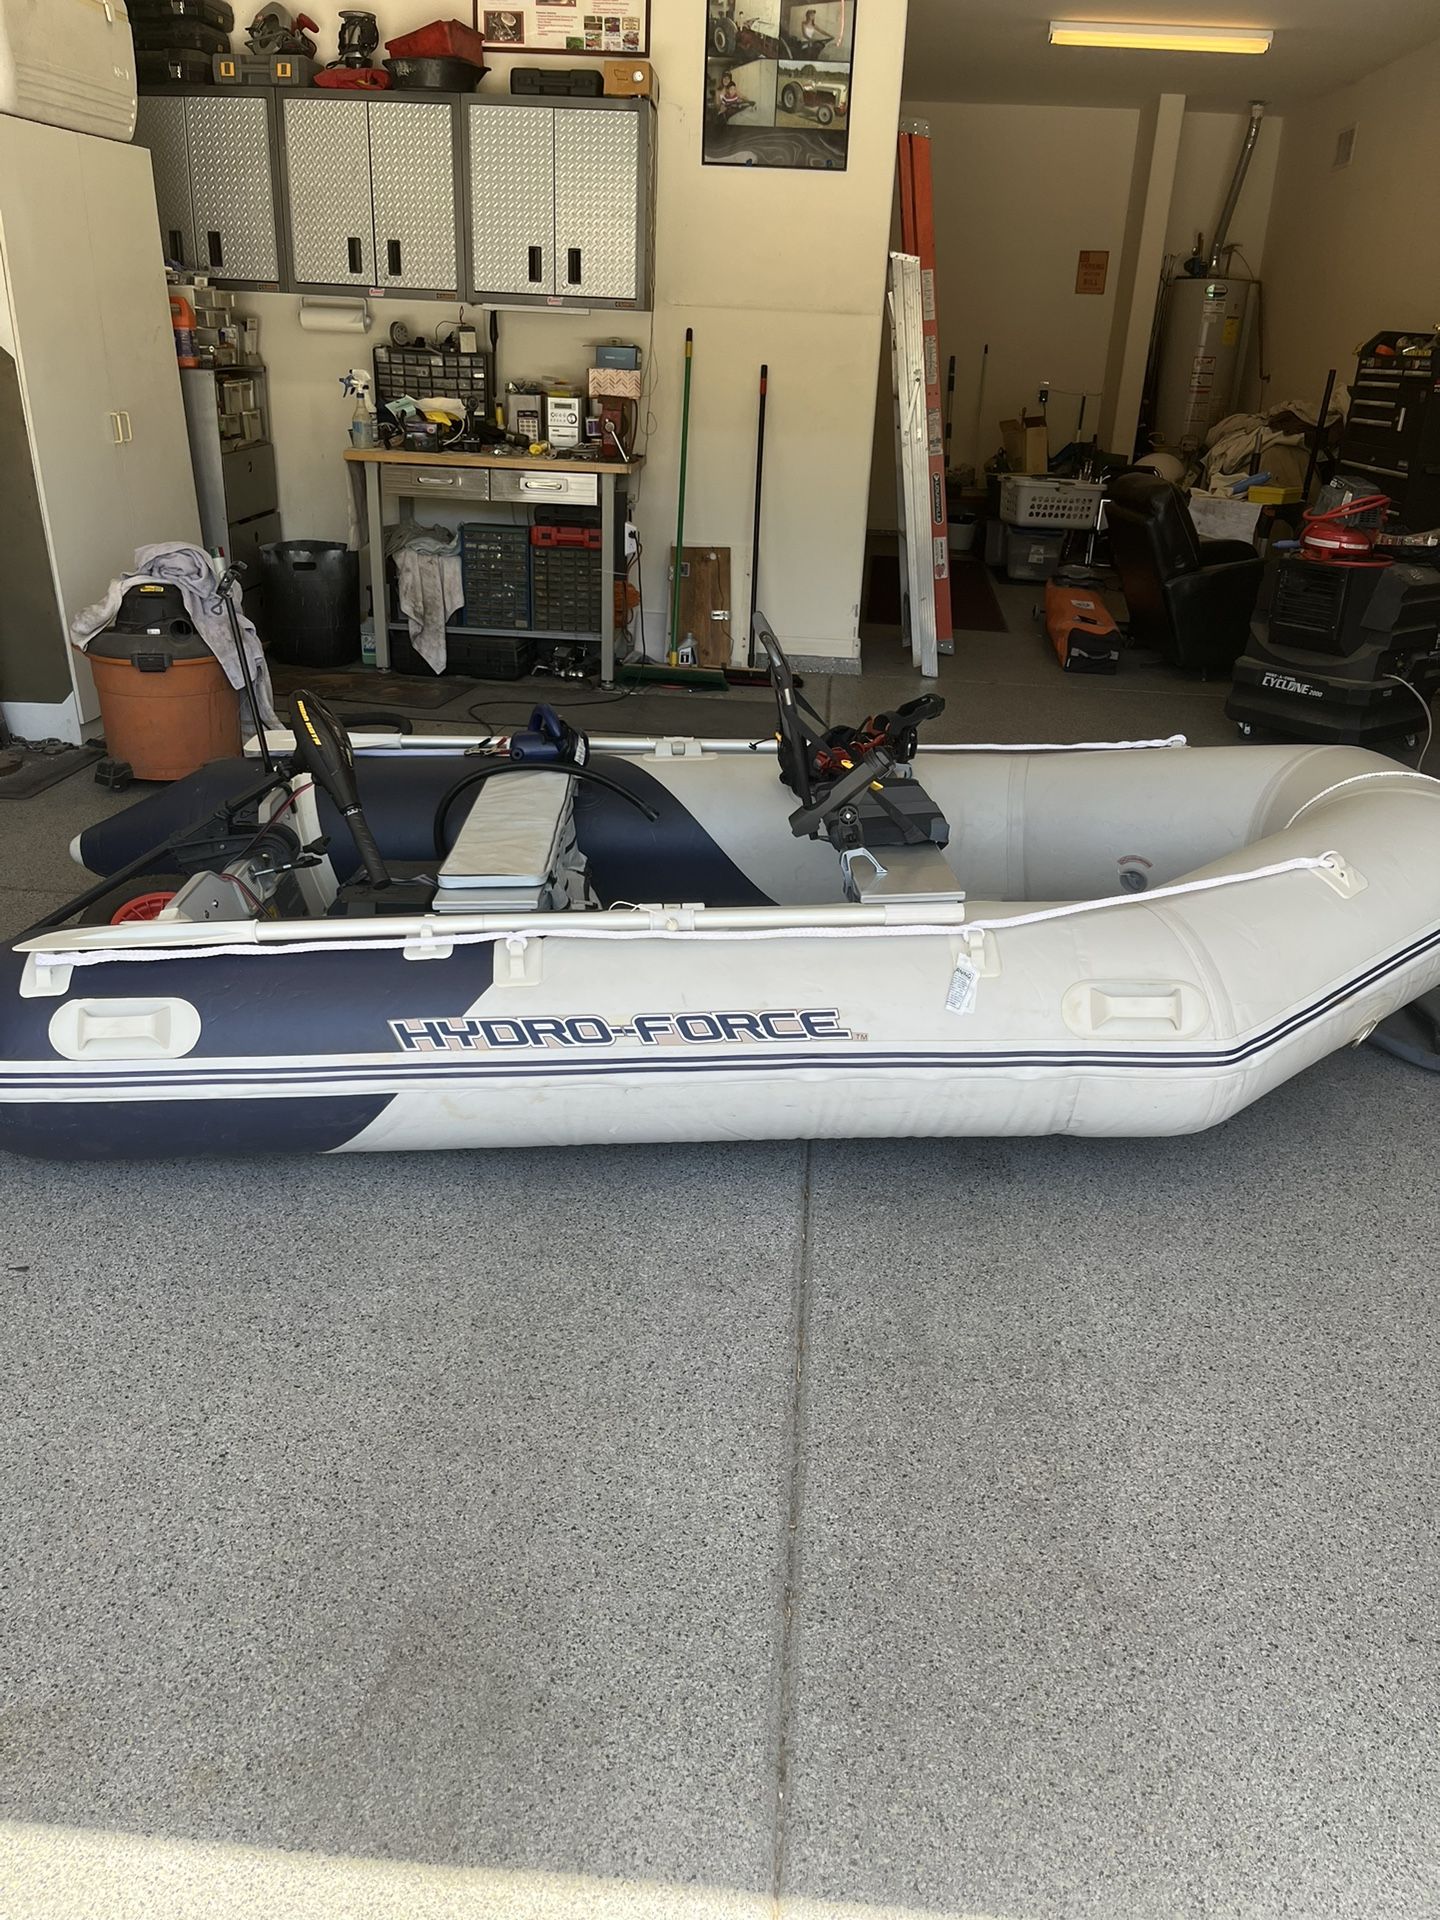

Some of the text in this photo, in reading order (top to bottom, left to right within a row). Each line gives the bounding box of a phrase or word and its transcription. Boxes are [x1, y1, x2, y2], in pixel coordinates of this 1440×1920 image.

[1262, 676, 1324, 698] CYCLONE 2000
[388, 1008, 852, 1051] HYDRO-FORCE
